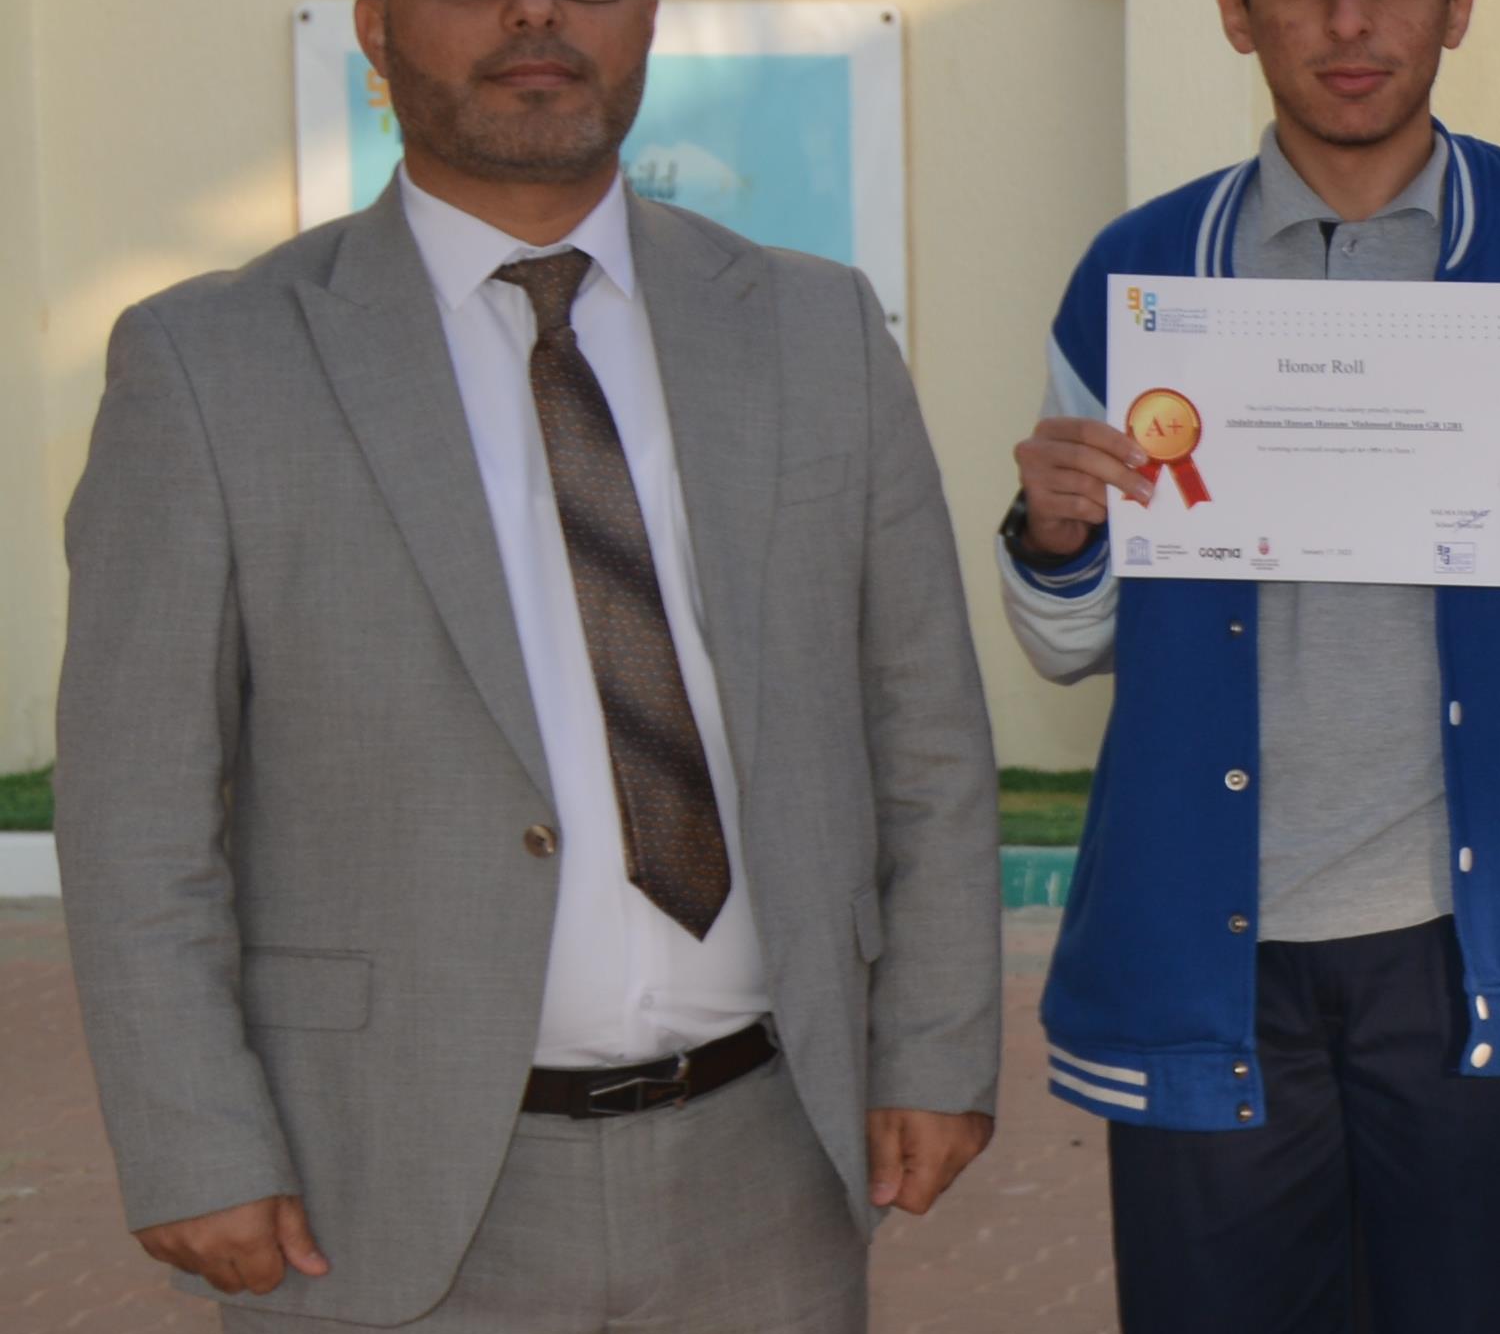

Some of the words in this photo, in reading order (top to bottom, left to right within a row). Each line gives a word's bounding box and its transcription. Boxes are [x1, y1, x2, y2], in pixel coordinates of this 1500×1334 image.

[1278, 358, 1325, 373] Honor
[1331, 359, 1364, 374] Roll
[1145, 415, 1185, 438] A+
[1198, 547, 1242, 561] cognia
